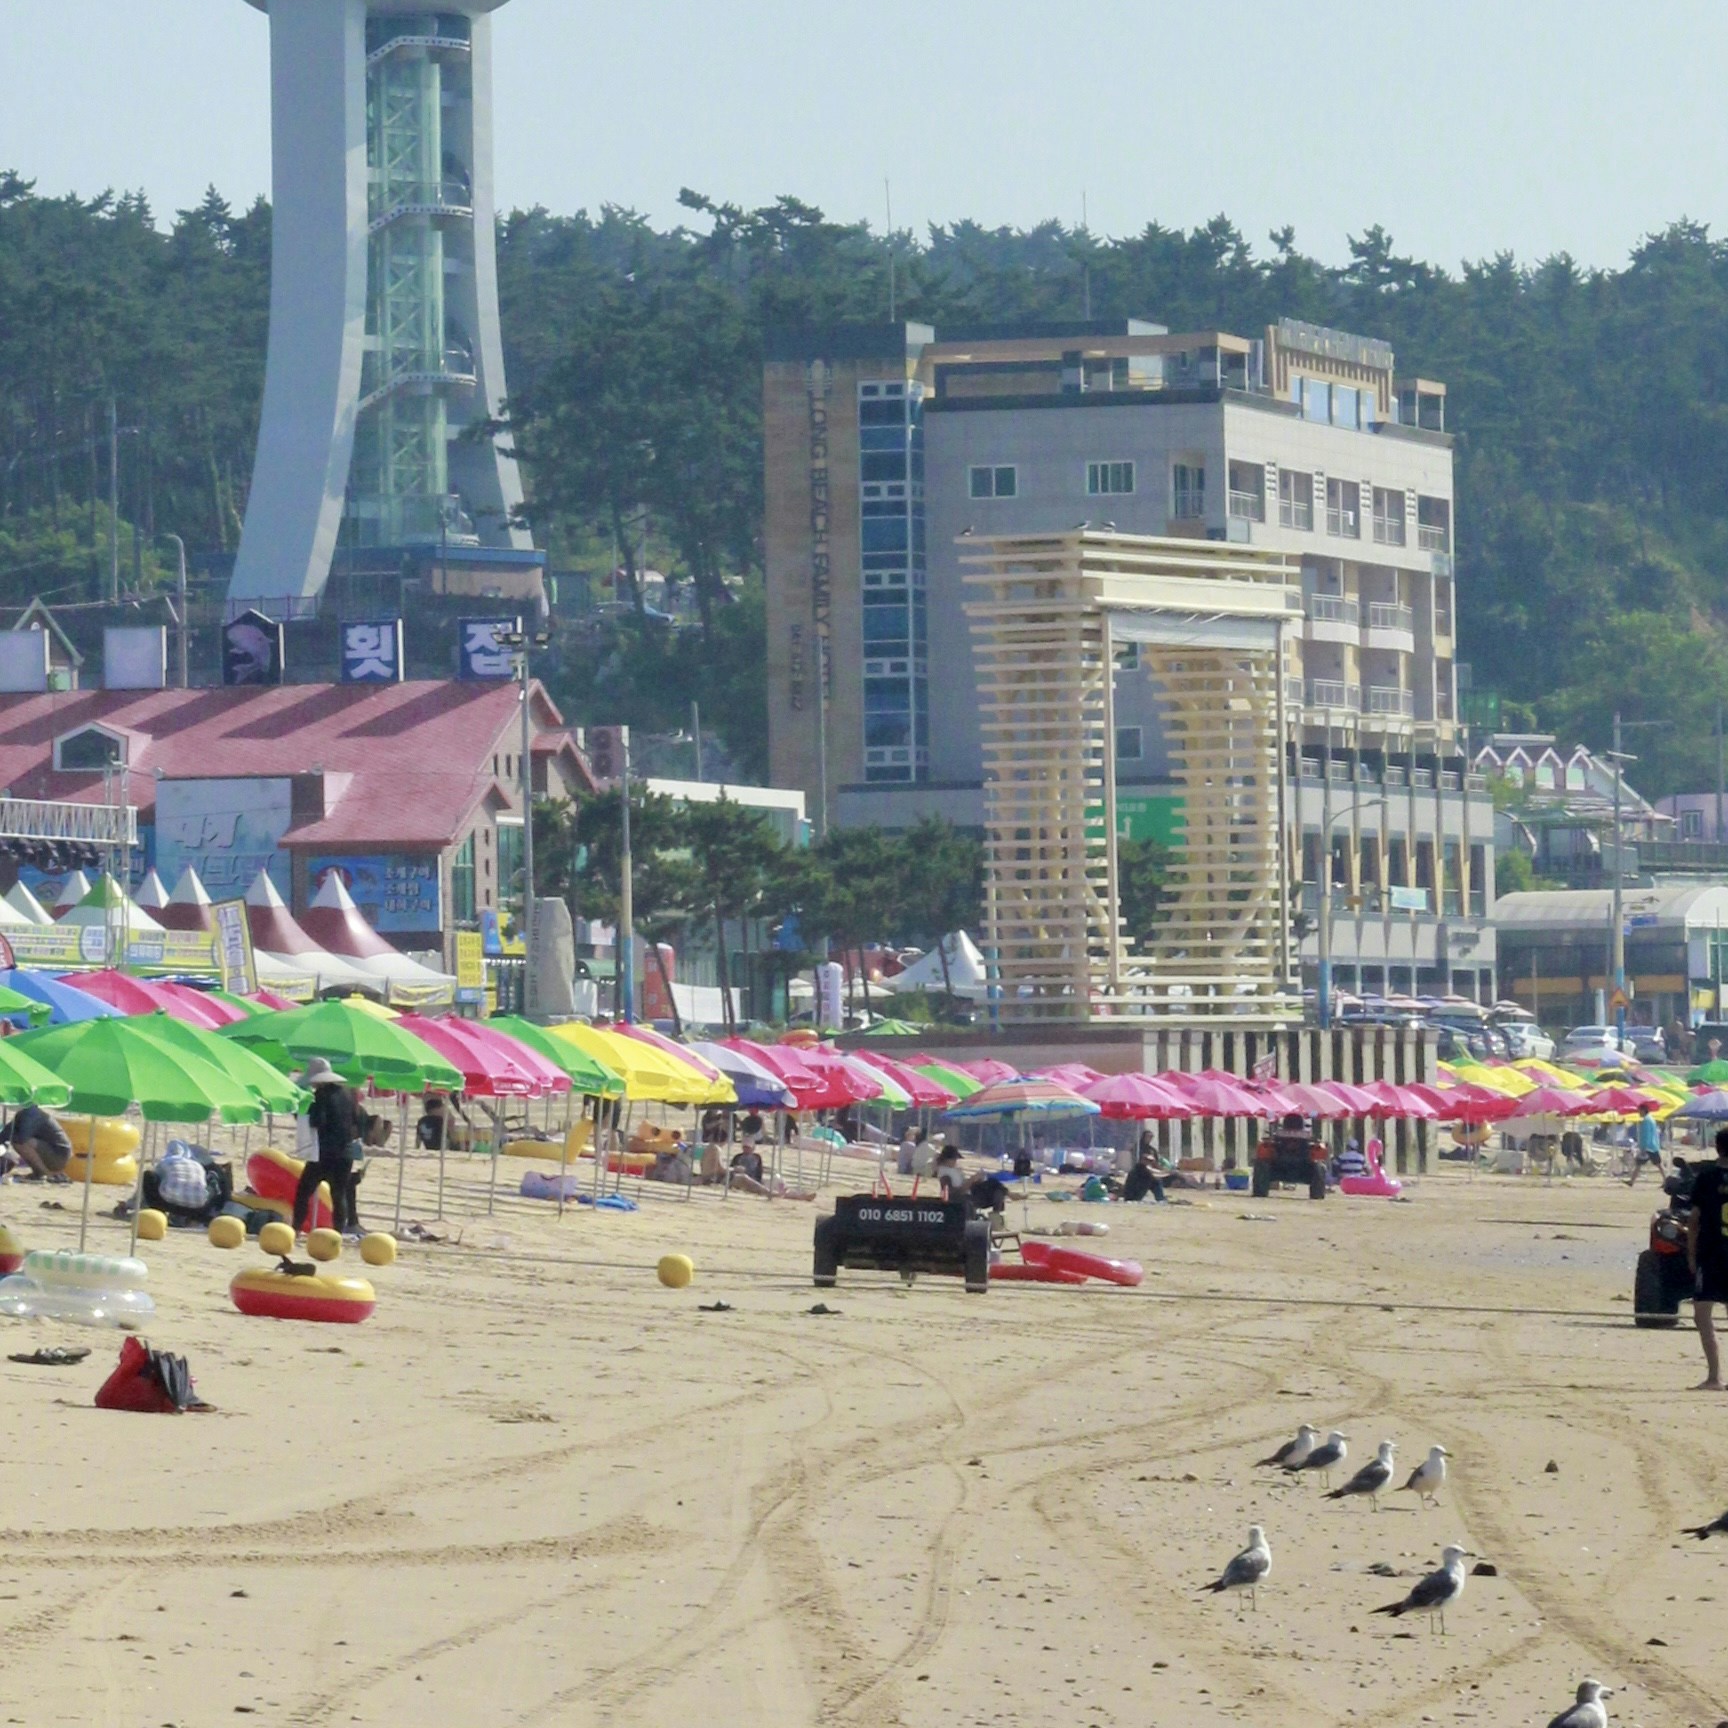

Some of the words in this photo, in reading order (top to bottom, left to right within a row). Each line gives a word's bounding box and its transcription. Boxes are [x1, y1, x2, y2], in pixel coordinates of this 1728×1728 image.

[809, 396, 829, 460] LONG
[810, 467, 829, 544] BEACH
[811, 553, 832, 626] FAMILY
[859, 1208, 881, 1221] 010
[884, 1209, 913, 1222] 6851
[918, 1211, 944, 1223] 1102
